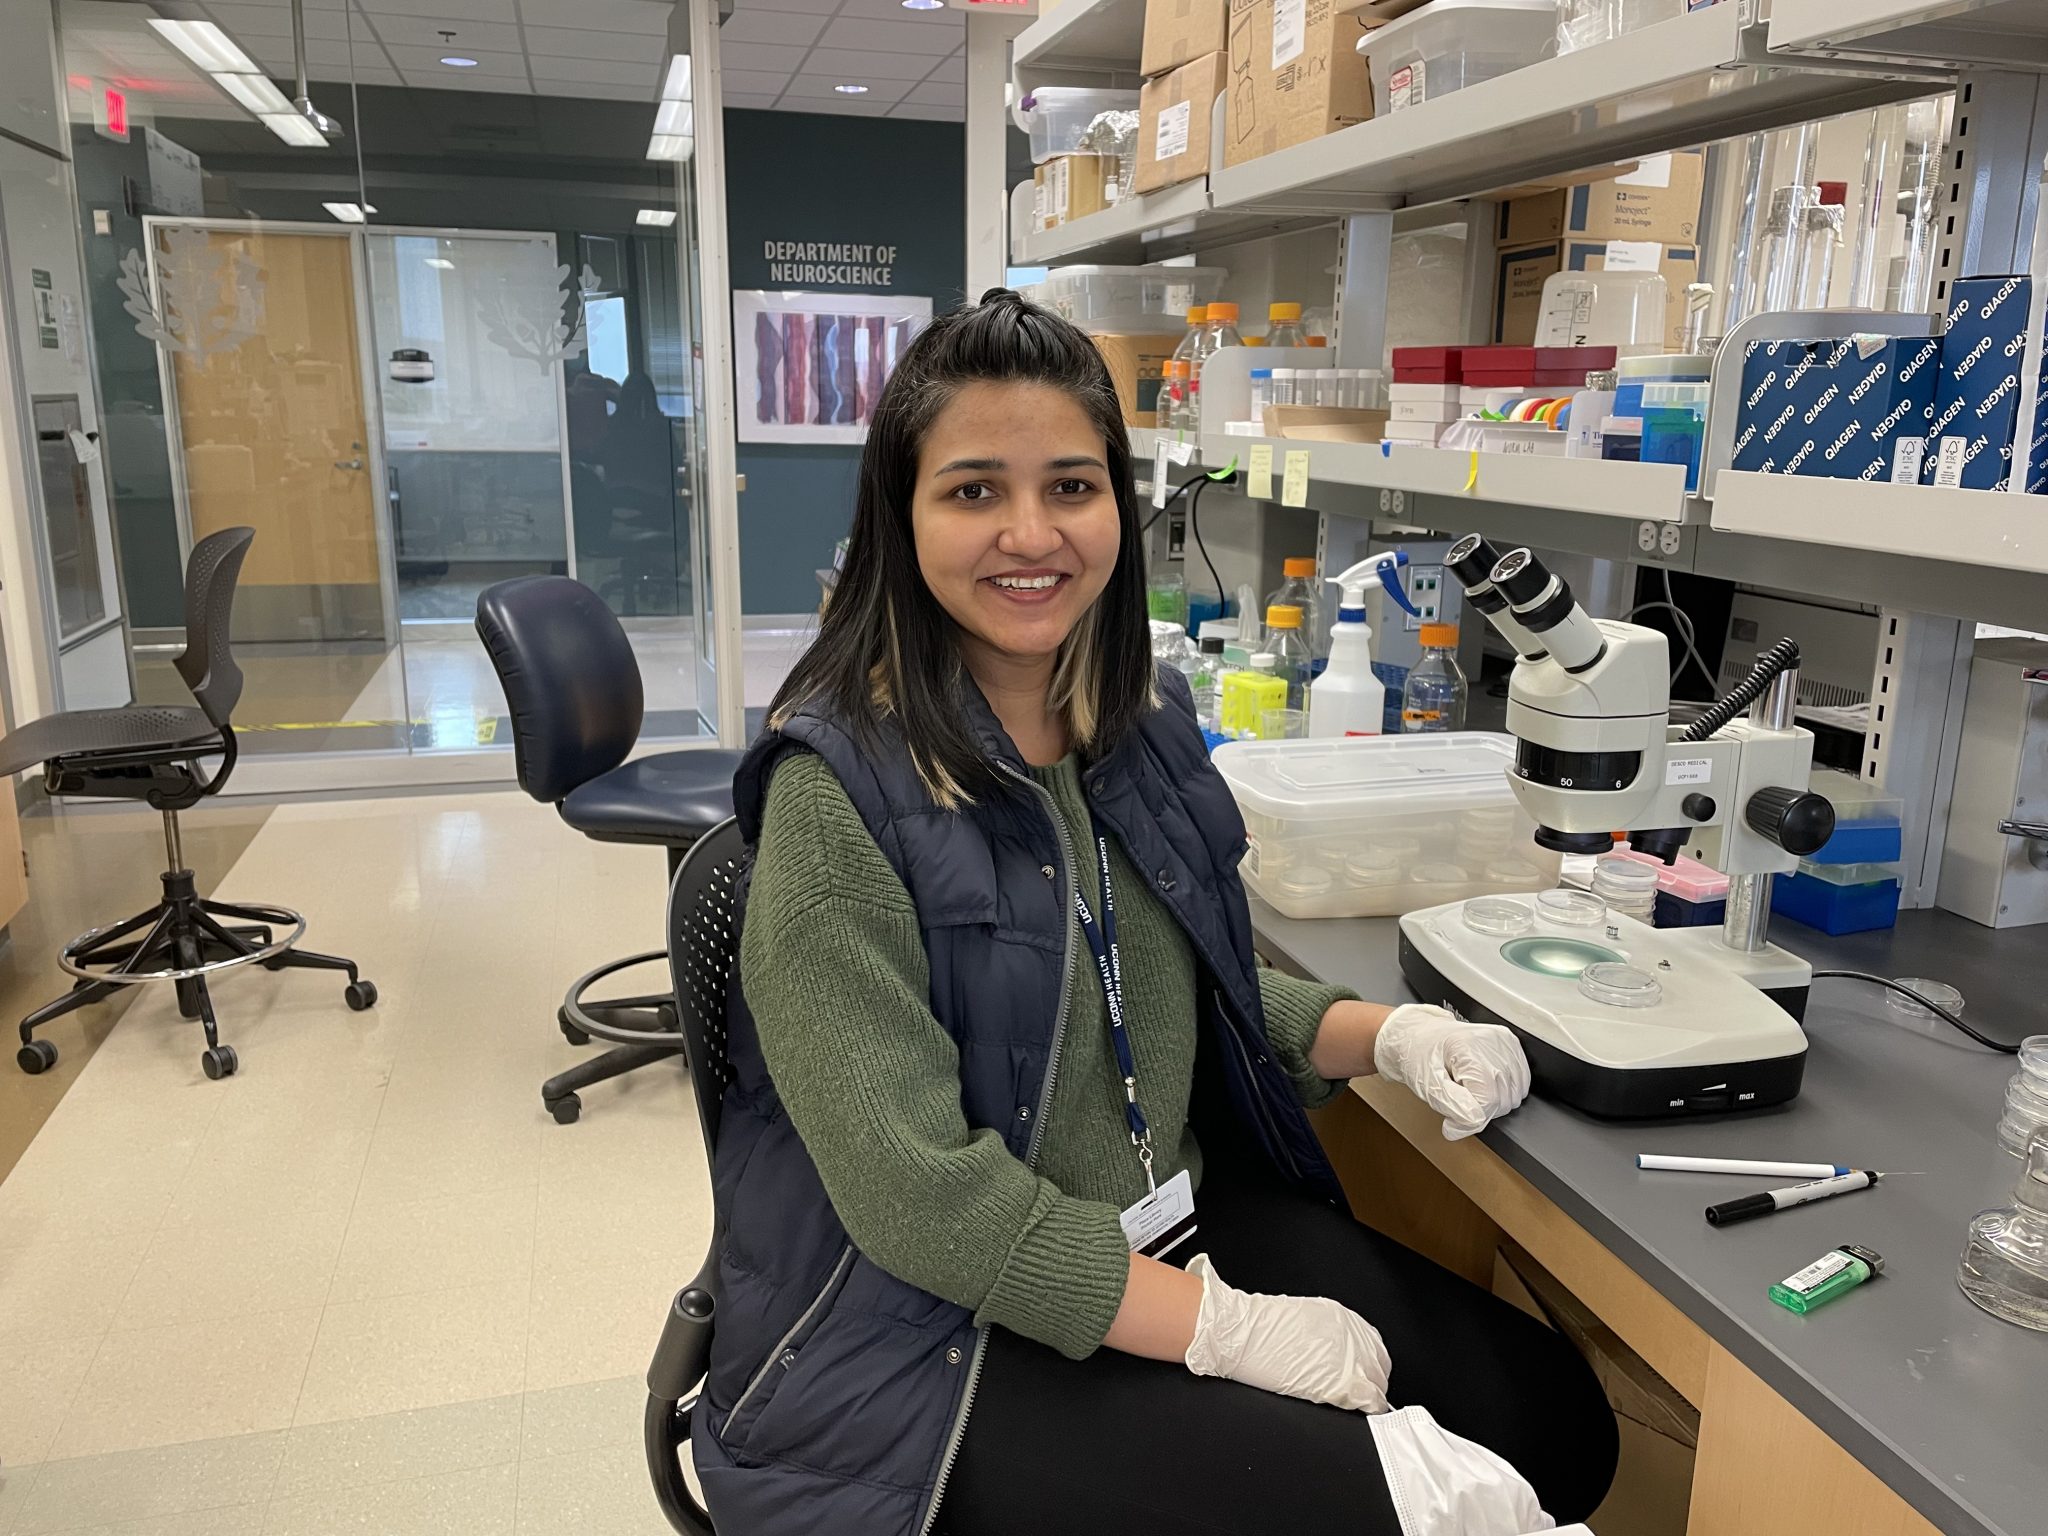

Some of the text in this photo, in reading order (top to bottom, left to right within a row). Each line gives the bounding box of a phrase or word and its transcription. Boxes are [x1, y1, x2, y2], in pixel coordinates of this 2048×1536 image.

[764, 240, 897, 265] DEPARTMENT OF
[770, 262, 892, 286] NEUROSCIENCE
[1980, 276, 2022, 320] QIAGEN
[1785, 352, 1817, 390] QIAGEN
[1899, 340, 1938, 383] QIAGEN
[1953, 336, 1992, 381] QIAGEN
[1746, 371, 1777, 410] QIAGEN
[1804, 383, 1839, 425] QIAGEN
[1849, 362, 1887, 405] QIAGEN
[1975, 374, 2017, 419] QIAGEN
[1764, 404, 1795, 444] QIAGEN
[1871, 399, 1912, 441] QIAGEN
[1929, 396, 1966, 439] QIAGEN
[1824, 420, 1861, 460] QIAGEN
[1521, 768, 1622, 789] 25 50 6
[1099, 837, 1114, 911] UCONN HEALTH
[1110, 943, 1121, 982] UCONN
[1098, 955, 1122, 1028] UCONN HEALTH
[1669, 1091, 1755, 1107] min max
